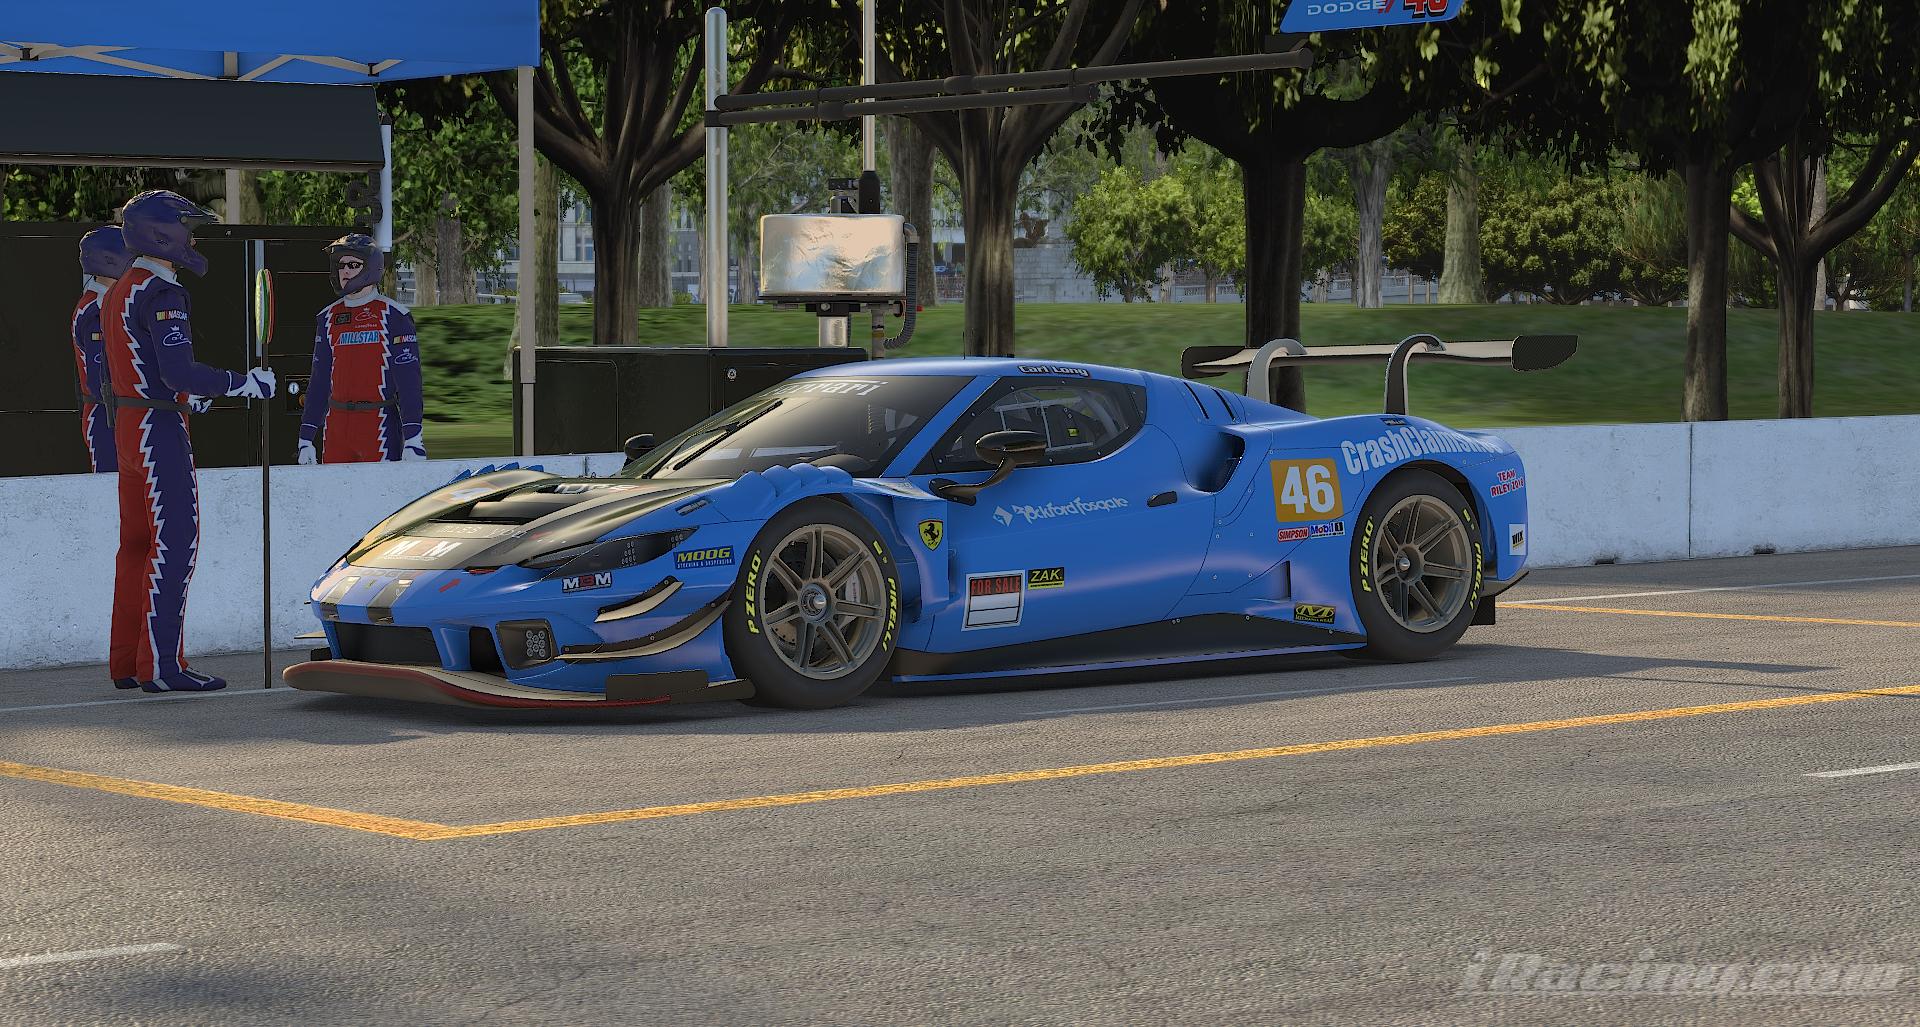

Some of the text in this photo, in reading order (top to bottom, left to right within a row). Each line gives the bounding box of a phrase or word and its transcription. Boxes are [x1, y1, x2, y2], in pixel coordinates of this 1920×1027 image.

[1307, 0, 1385, 15] DODGE
[339, 331, 380, 345] MILLSTAR
[1018, 365, 1089, 377] Carl Long
[1497, 469, 1515, 483] TEAM
[1281, 465, 1335, 513] 46
[1490, 483, 1510, 497] RILEY
[1279, 529, 1308, 540] SIMPSON
[1310, 523, 1334, 535] Mobil
[677, 548, 731, 563] MOOG
[971, 576, 1020, 595] FOR SALE
